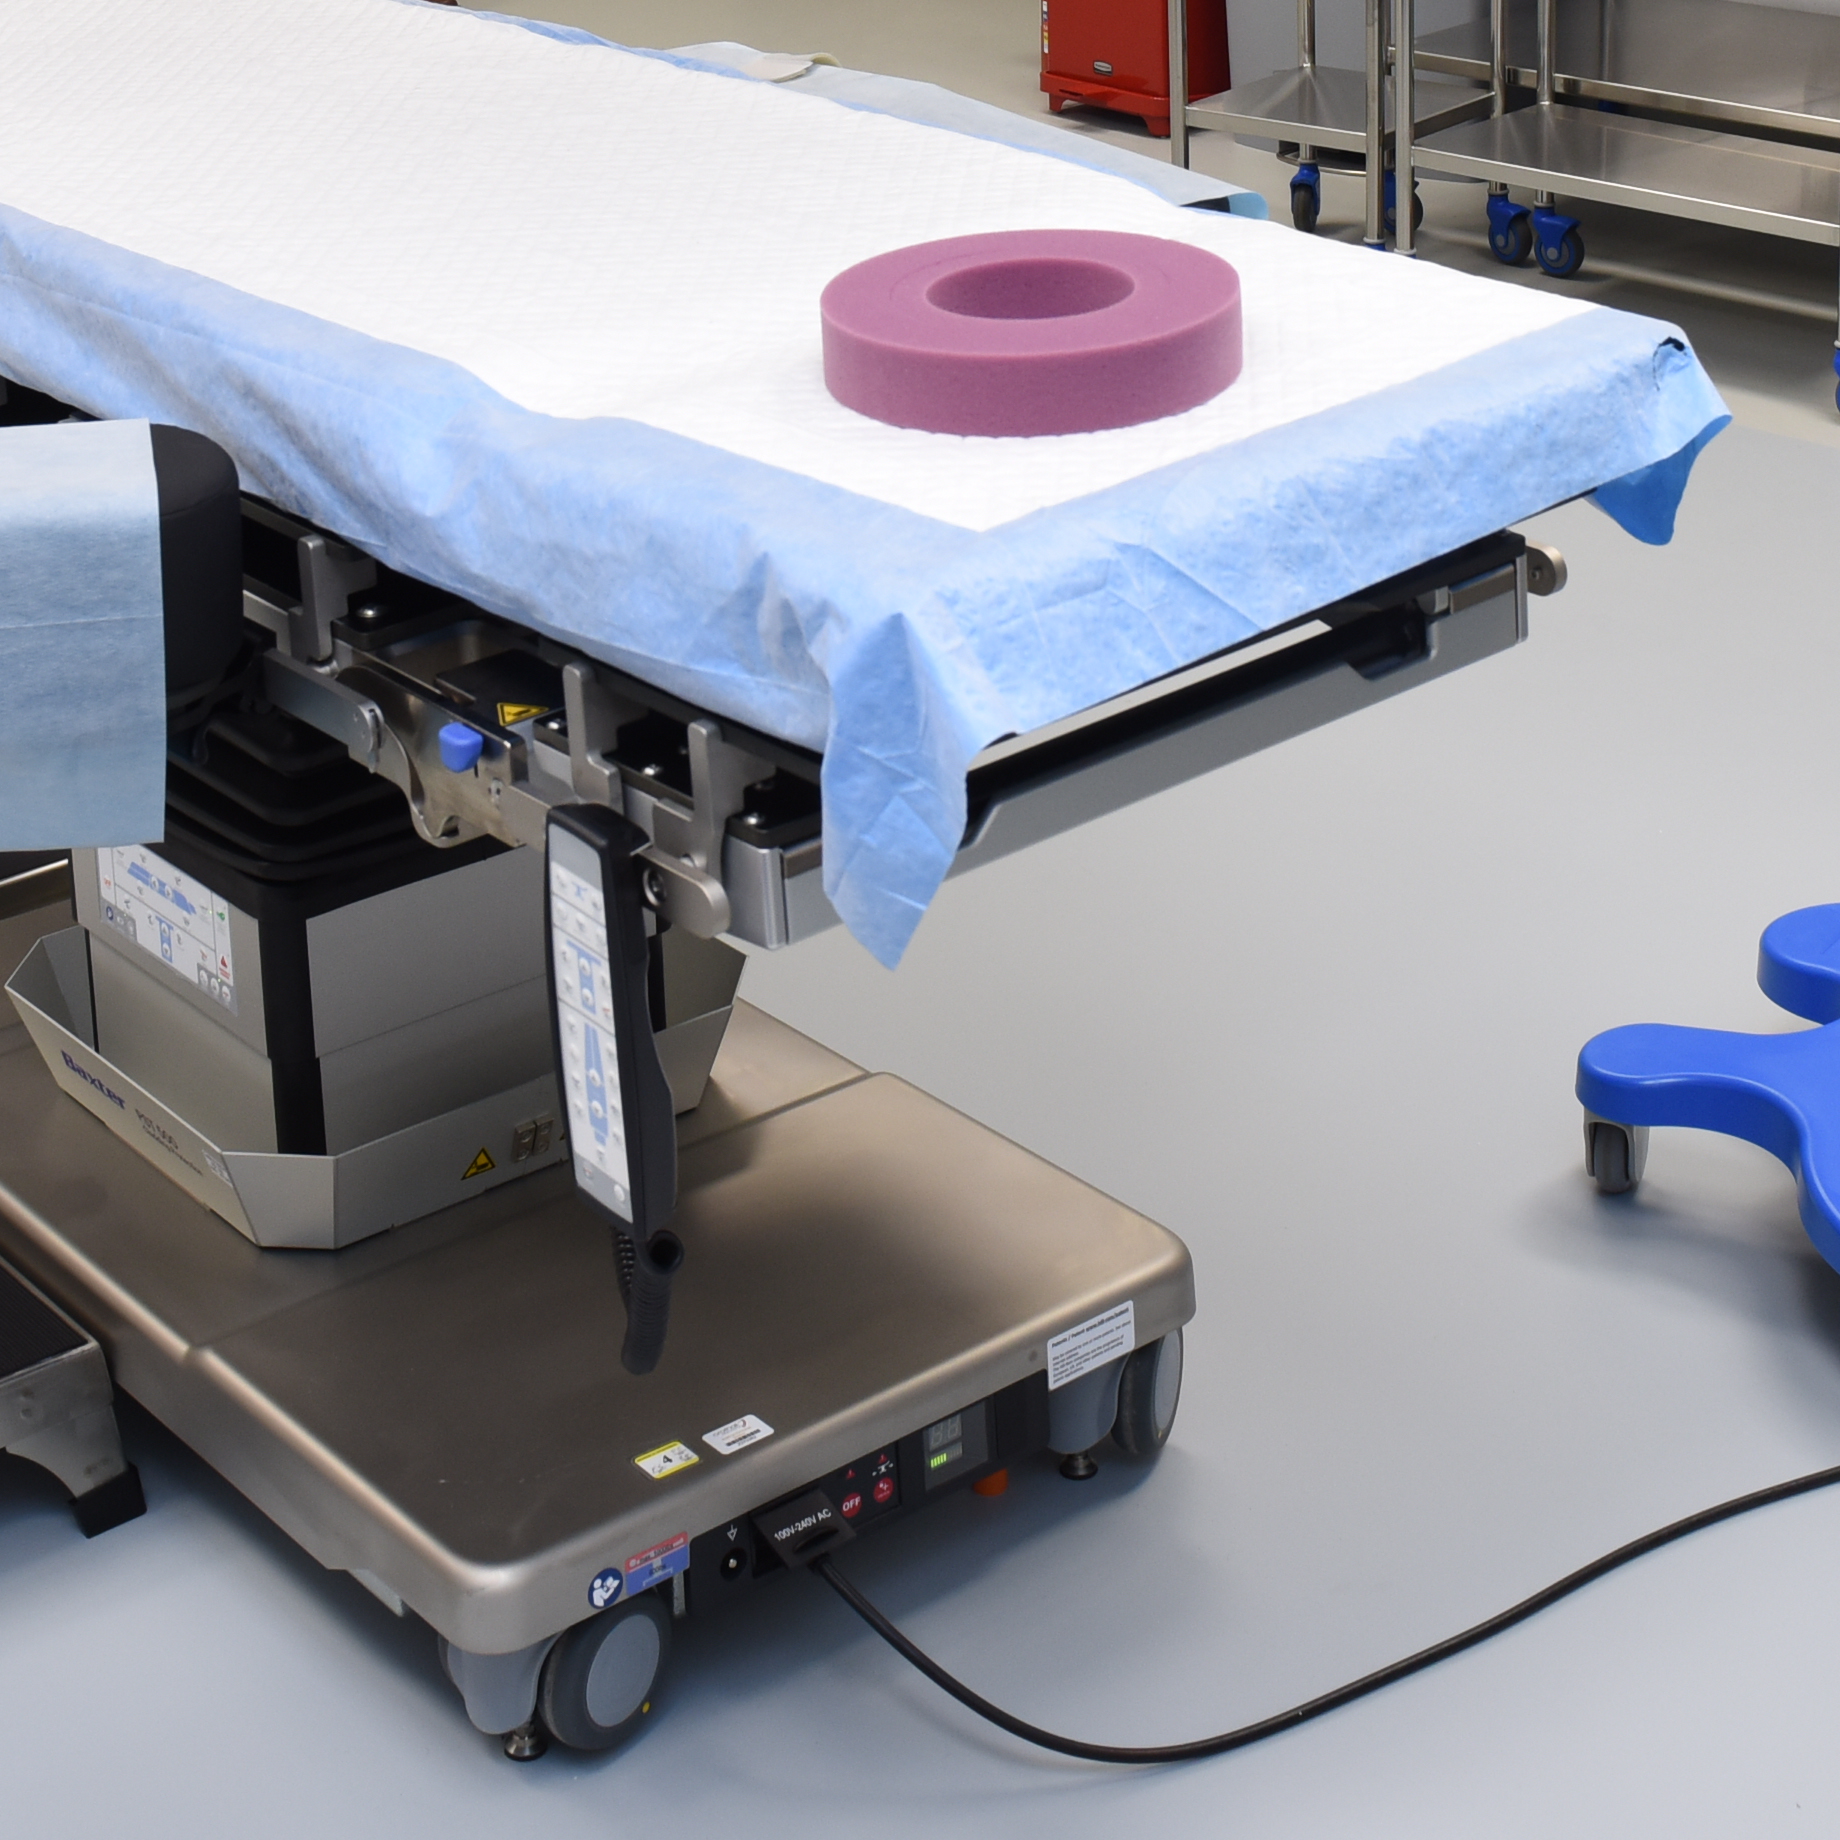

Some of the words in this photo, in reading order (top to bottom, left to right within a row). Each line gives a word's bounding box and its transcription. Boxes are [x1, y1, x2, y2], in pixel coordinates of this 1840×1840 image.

[61, 1049, 125, 1110] Baxter
[662, 1454, 673, 1464] 4
[842, 1496, 861, 1512] OFF
[773, 1515, 818, 1542] 100V-240V
[817, 1508, 832, 1523] AC
